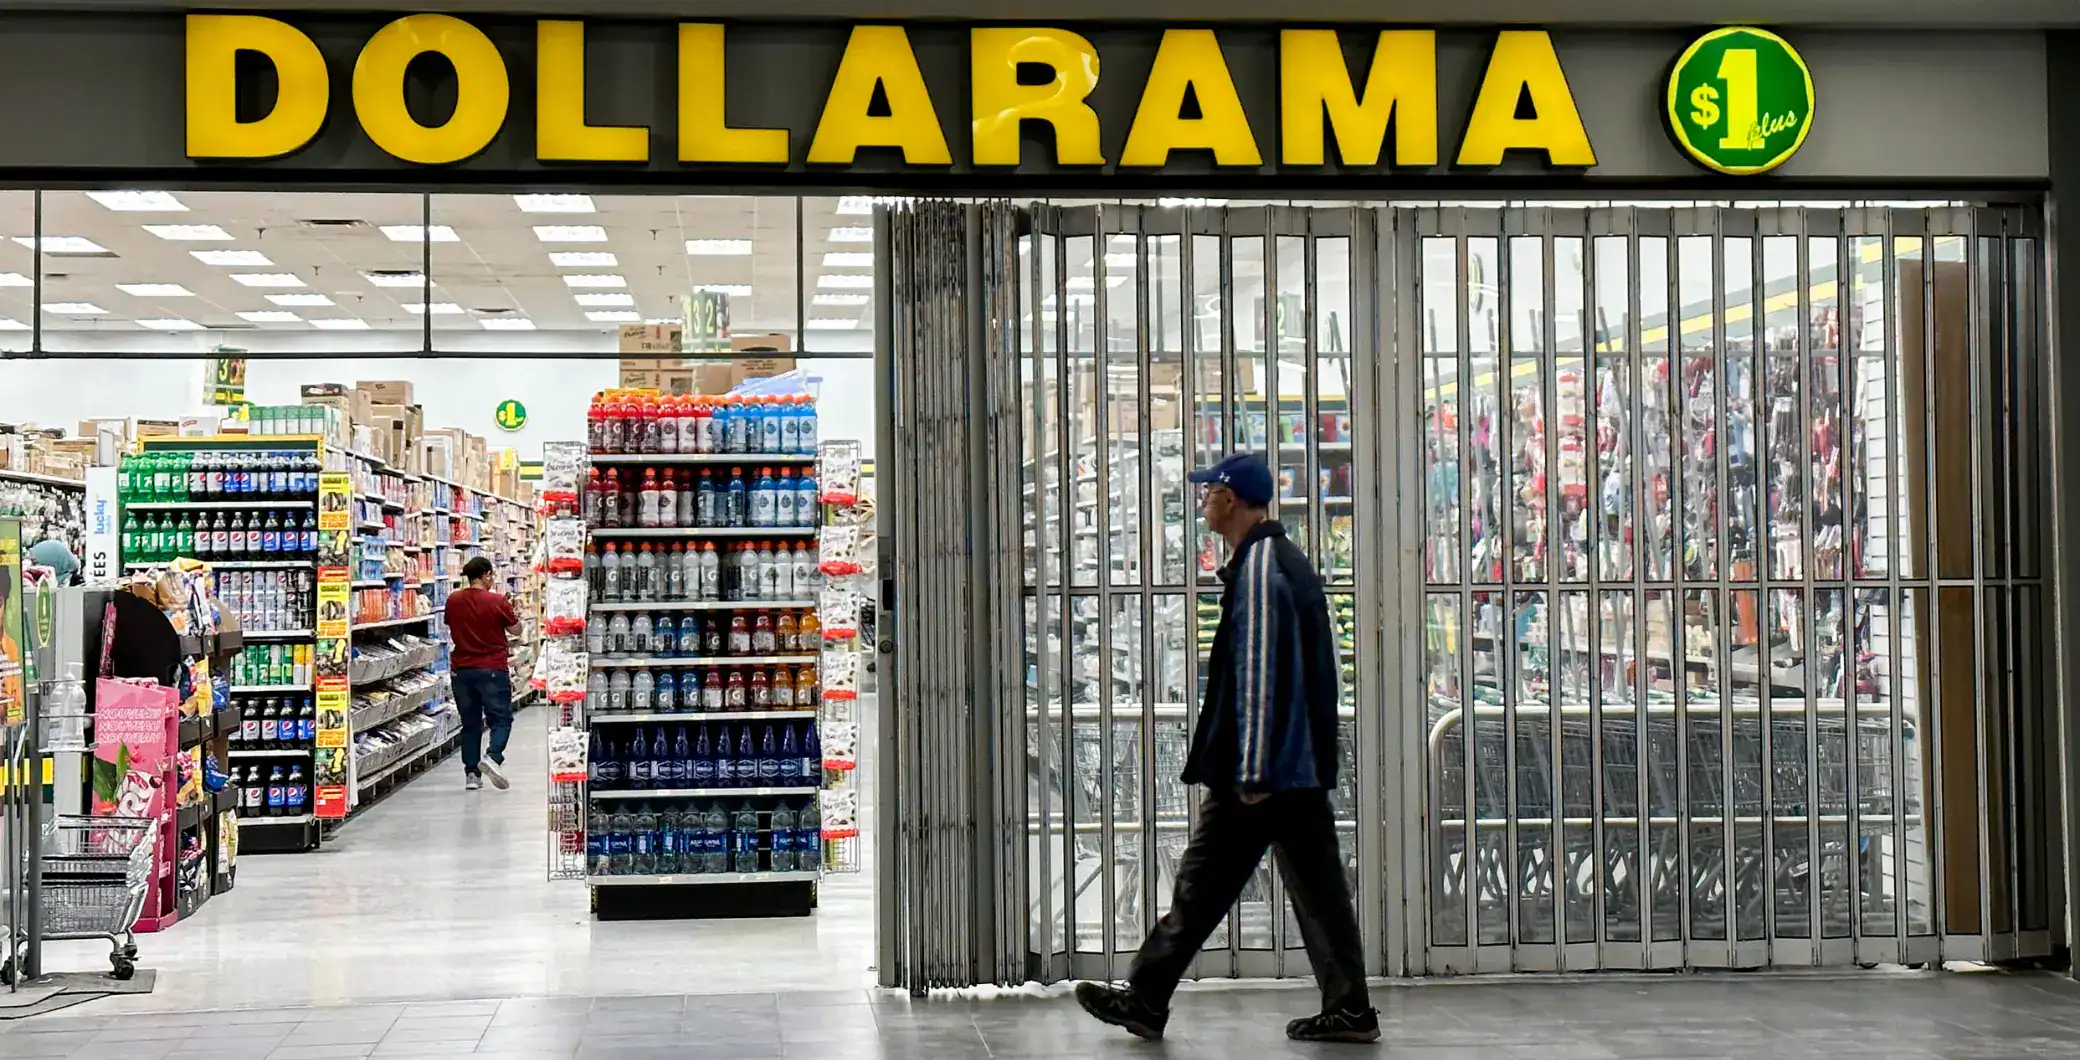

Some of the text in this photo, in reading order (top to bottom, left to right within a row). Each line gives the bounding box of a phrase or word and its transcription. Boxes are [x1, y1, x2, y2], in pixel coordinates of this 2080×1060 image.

[185, 13, 1597, 167] DOLLARAMA
[1690, 48, 1765, 149] $1
[1747, 110, 1798, 151] plus
[94, 499, 107, 535] lucky
[89, 551, 106, 579] ÉES
